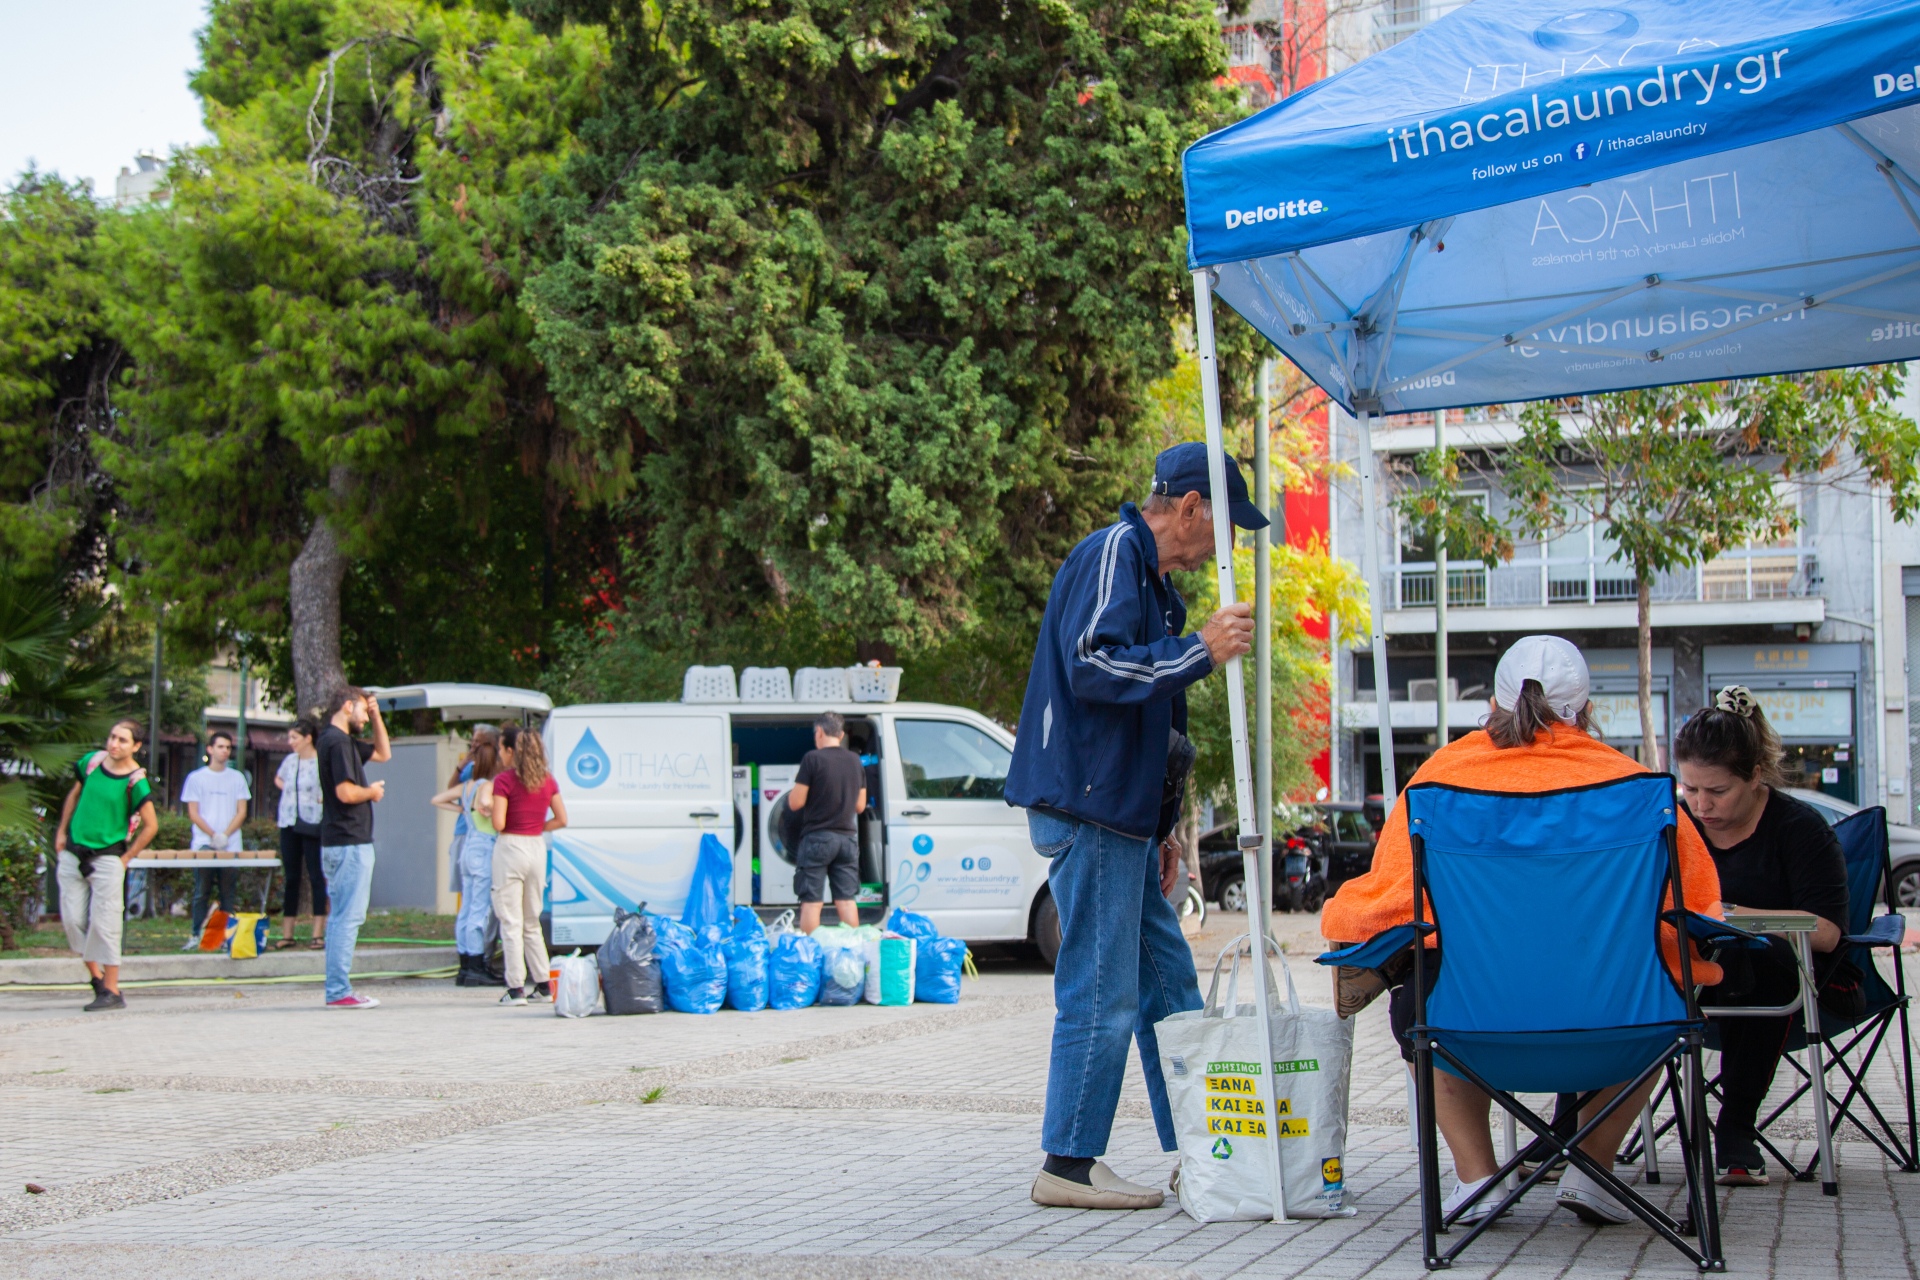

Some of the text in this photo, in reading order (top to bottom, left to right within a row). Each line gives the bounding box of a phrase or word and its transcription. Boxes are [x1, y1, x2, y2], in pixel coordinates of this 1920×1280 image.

[1387, 48, 1790, 163] ithacalaundry.gr
[1472, 163, 1517, 181] follow
[1522, 157, 1539, 170] us
[1543, 152, 1563, 165] on
[1608, 122, 1707, 151] ithacalaundry
[1225, 198, 1329, 230] Deloitte.
[618, 753, 710, 778] ITHACA
[1299, 1061, 1316, 1070] ΜΕ
[1210, 1079, 1252, 1092] ΞΑΝΑ
[1211, 1099, 1288, 1114] ΚΑΙ ΞΑΑ
[1211, 1119, 1307, 1135] ΚΑΙ ΞΑΑ...
